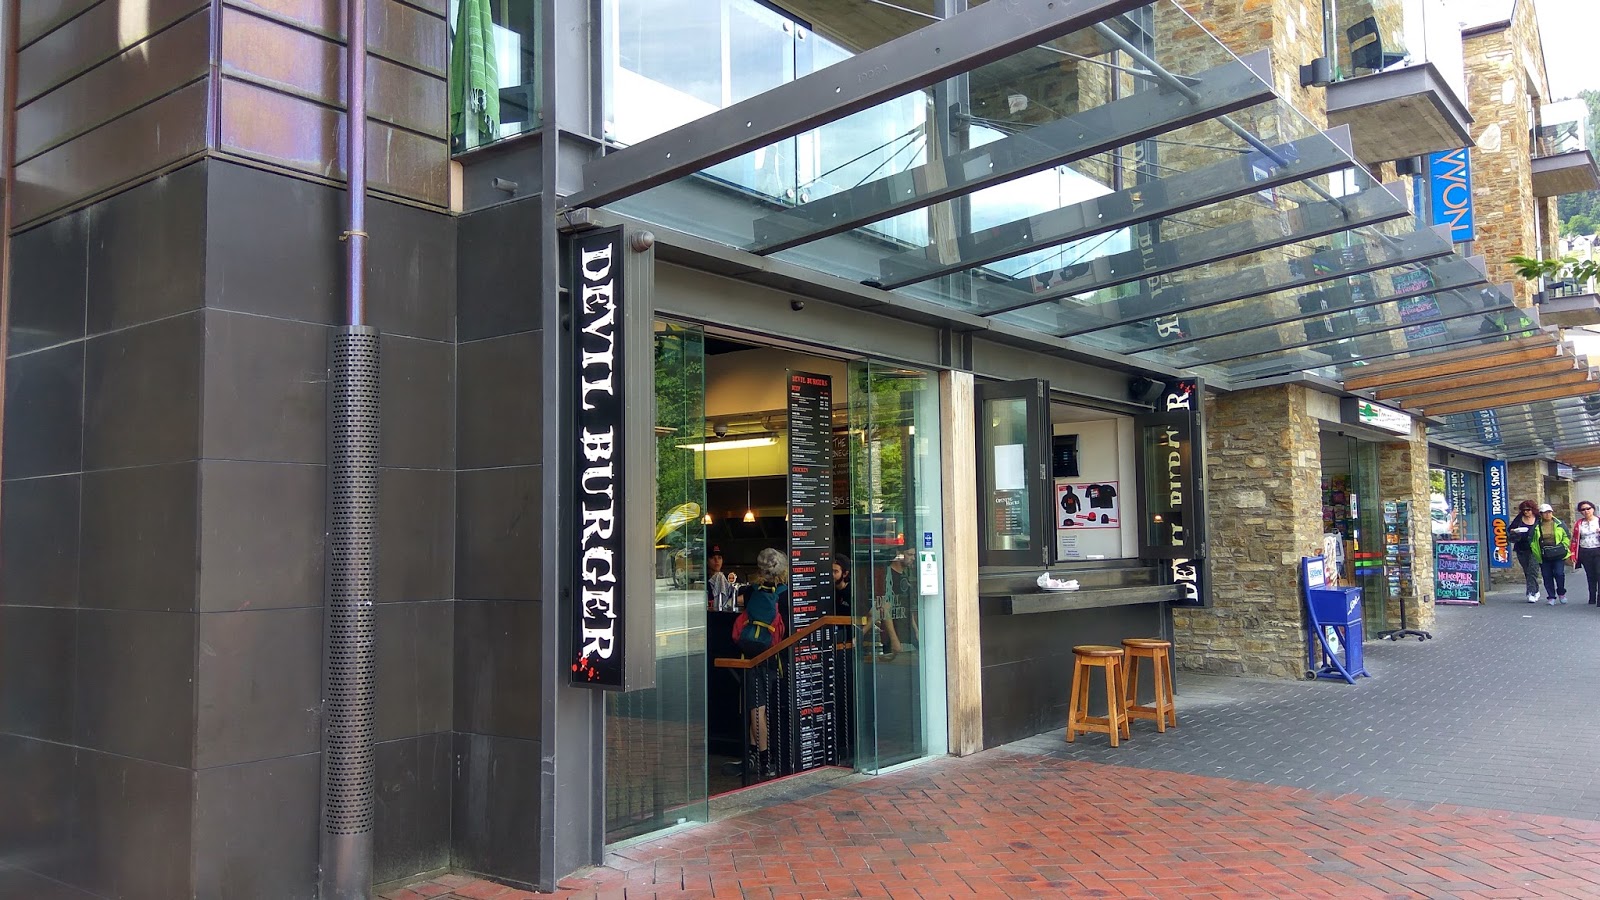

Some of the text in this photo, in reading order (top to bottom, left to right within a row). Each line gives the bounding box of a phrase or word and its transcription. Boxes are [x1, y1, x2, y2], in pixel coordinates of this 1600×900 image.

[581, 242, 618, 661] DEVIL BURGER
[1492, 488, 1502, 516] TRAVEL
